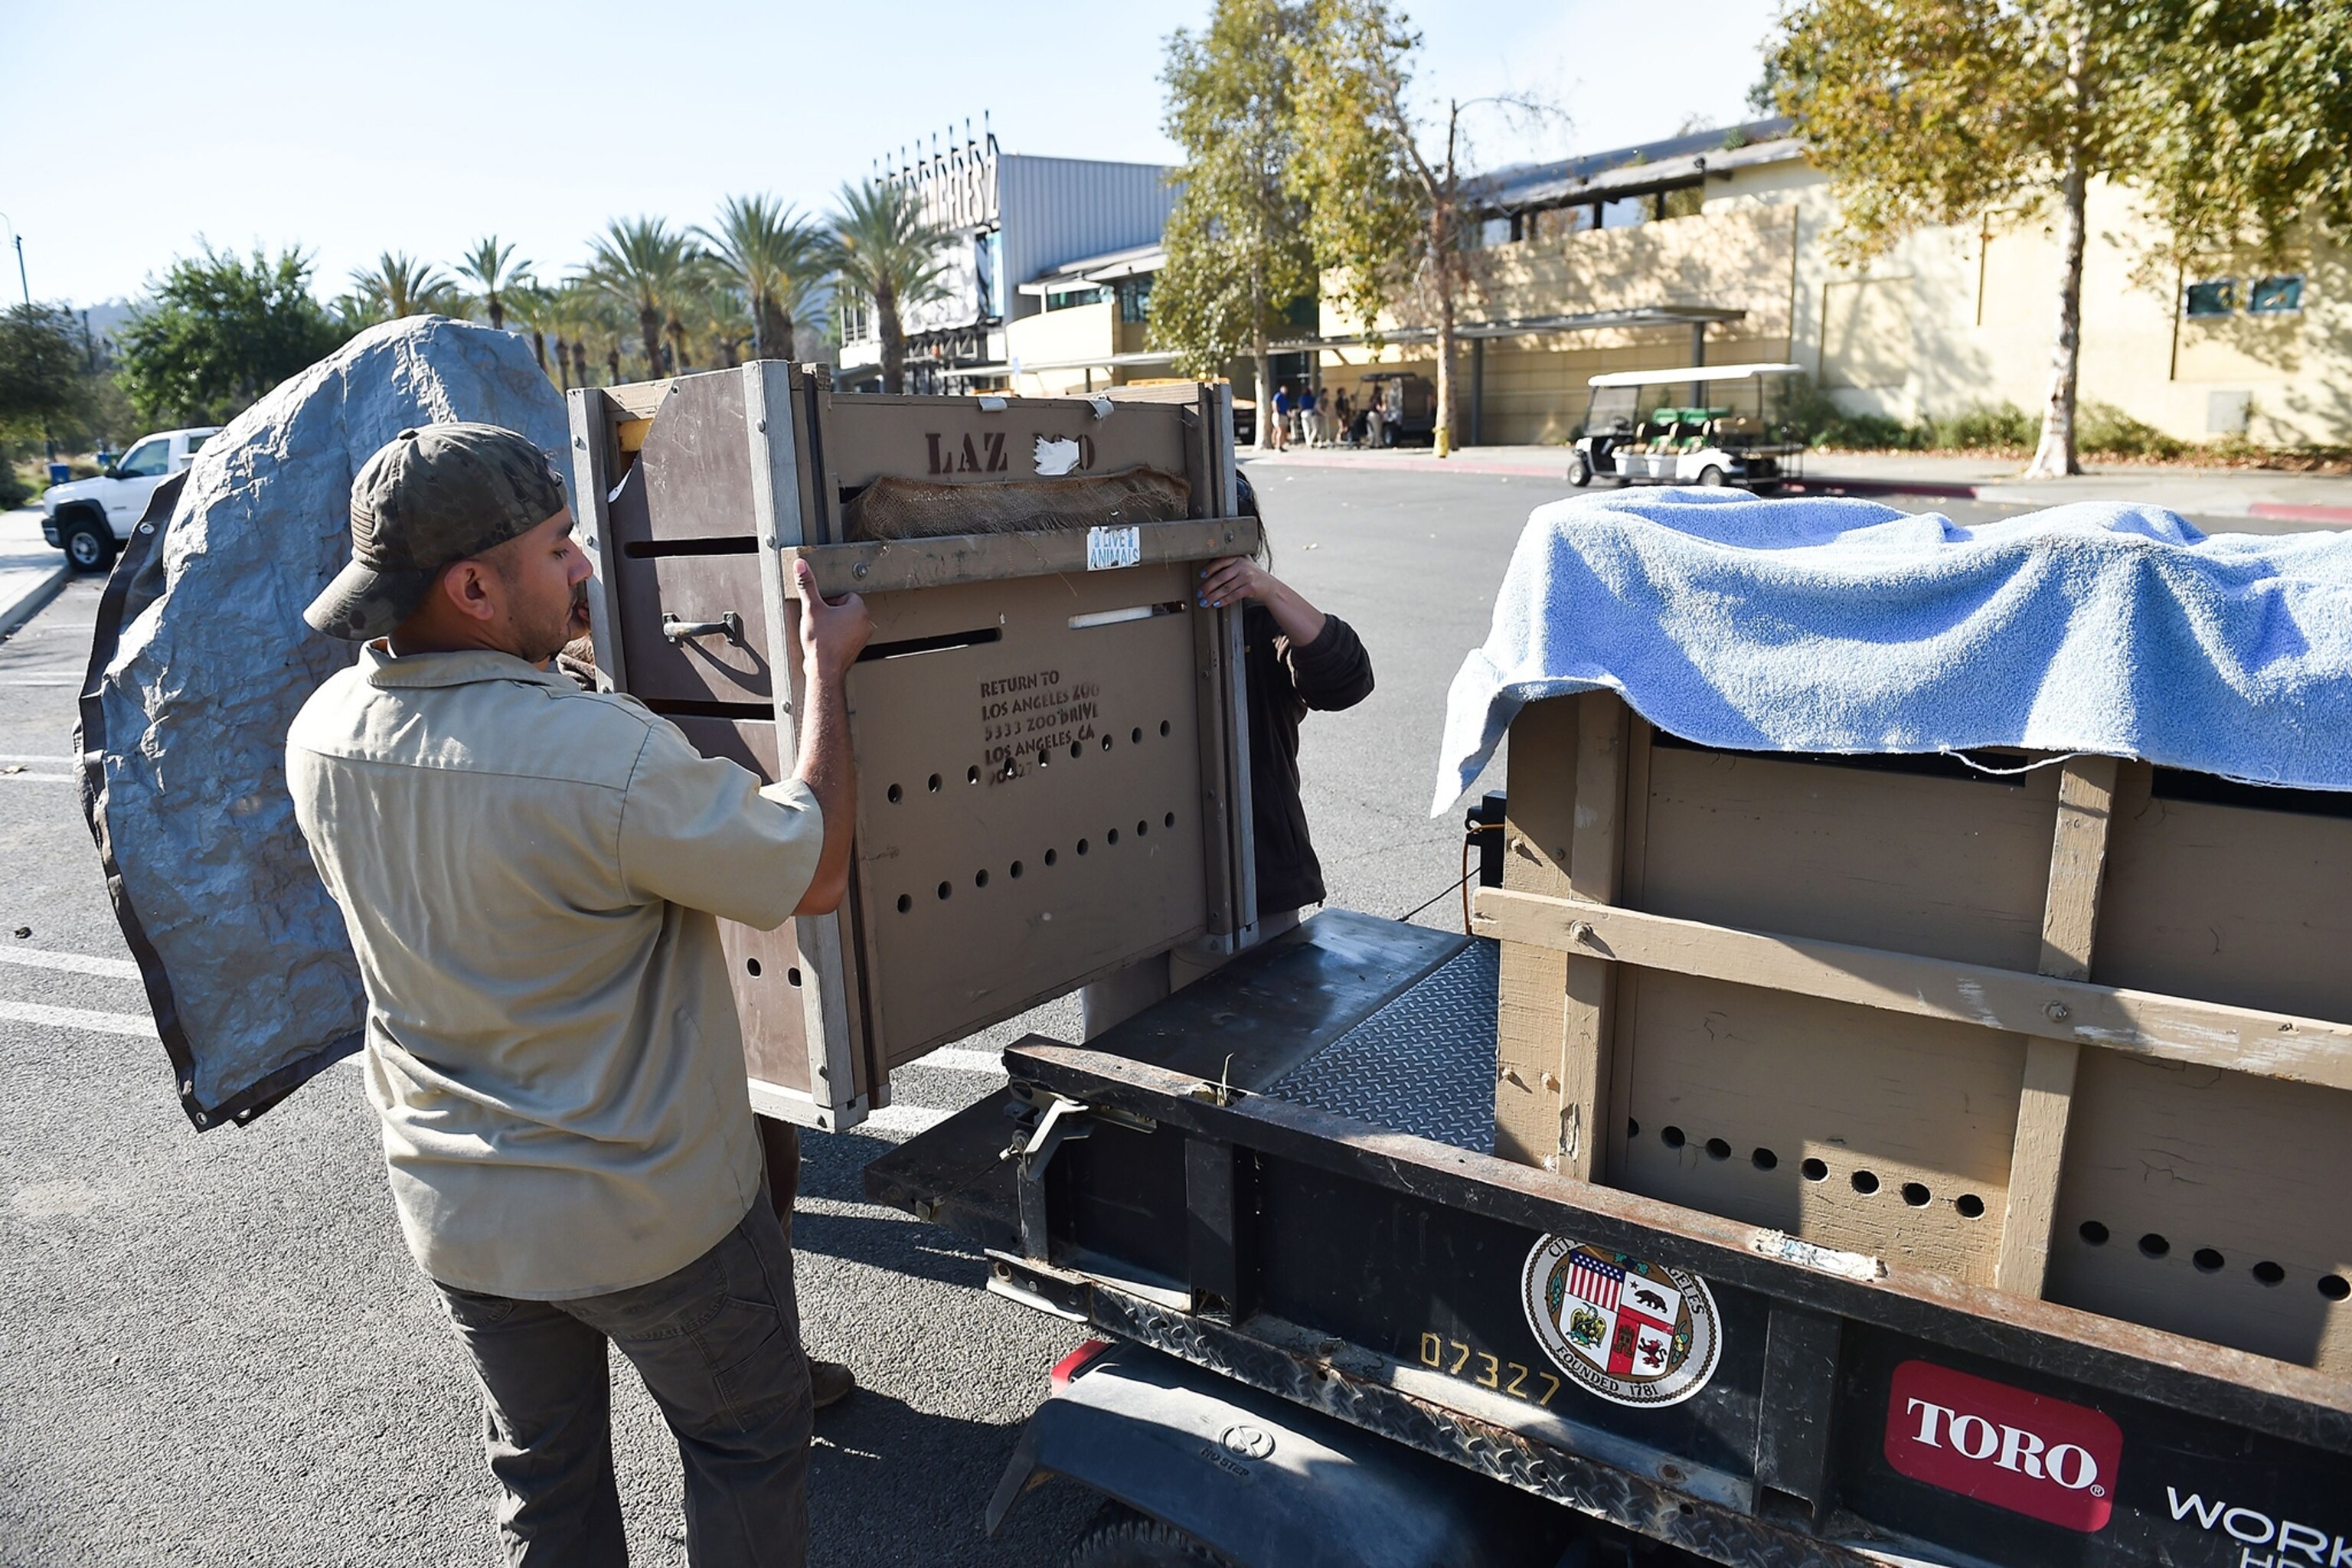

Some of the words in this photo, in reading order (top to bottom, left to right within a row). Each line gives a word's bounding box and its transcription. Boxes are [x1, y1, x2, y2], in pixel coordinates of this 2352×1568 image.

[1103, 531, 1125, 547] LIVE
[1089, 548, 1138, 567] ANIMALS
[981, 674, 1037, 697] RETURN
[1040, 670, 1060, 686] TO
[982, 701, 1008, 721] LOS
[1012, 691, 1069, 714] ANGELES
[1073, 682, 1099, 701] ZOO
[1027, 714, 1057, 732] ZOO
[985, 744, 1011, 765] LOS
[1078, 723, 1095, 741] CA
[1548, 1237, 1578, 1257] CIT
[1669, 1269, 1705, 1314] GELES
[1421, 1331, 1560, 1406] 07327
[1557, 1346, 1619, 1392] FOUNDED
[1629, 1384, 1659, 1396] 1781
[1200, 1447, 1220, 1461] NO
[1220, 1457, 1250, 1476] STEP
